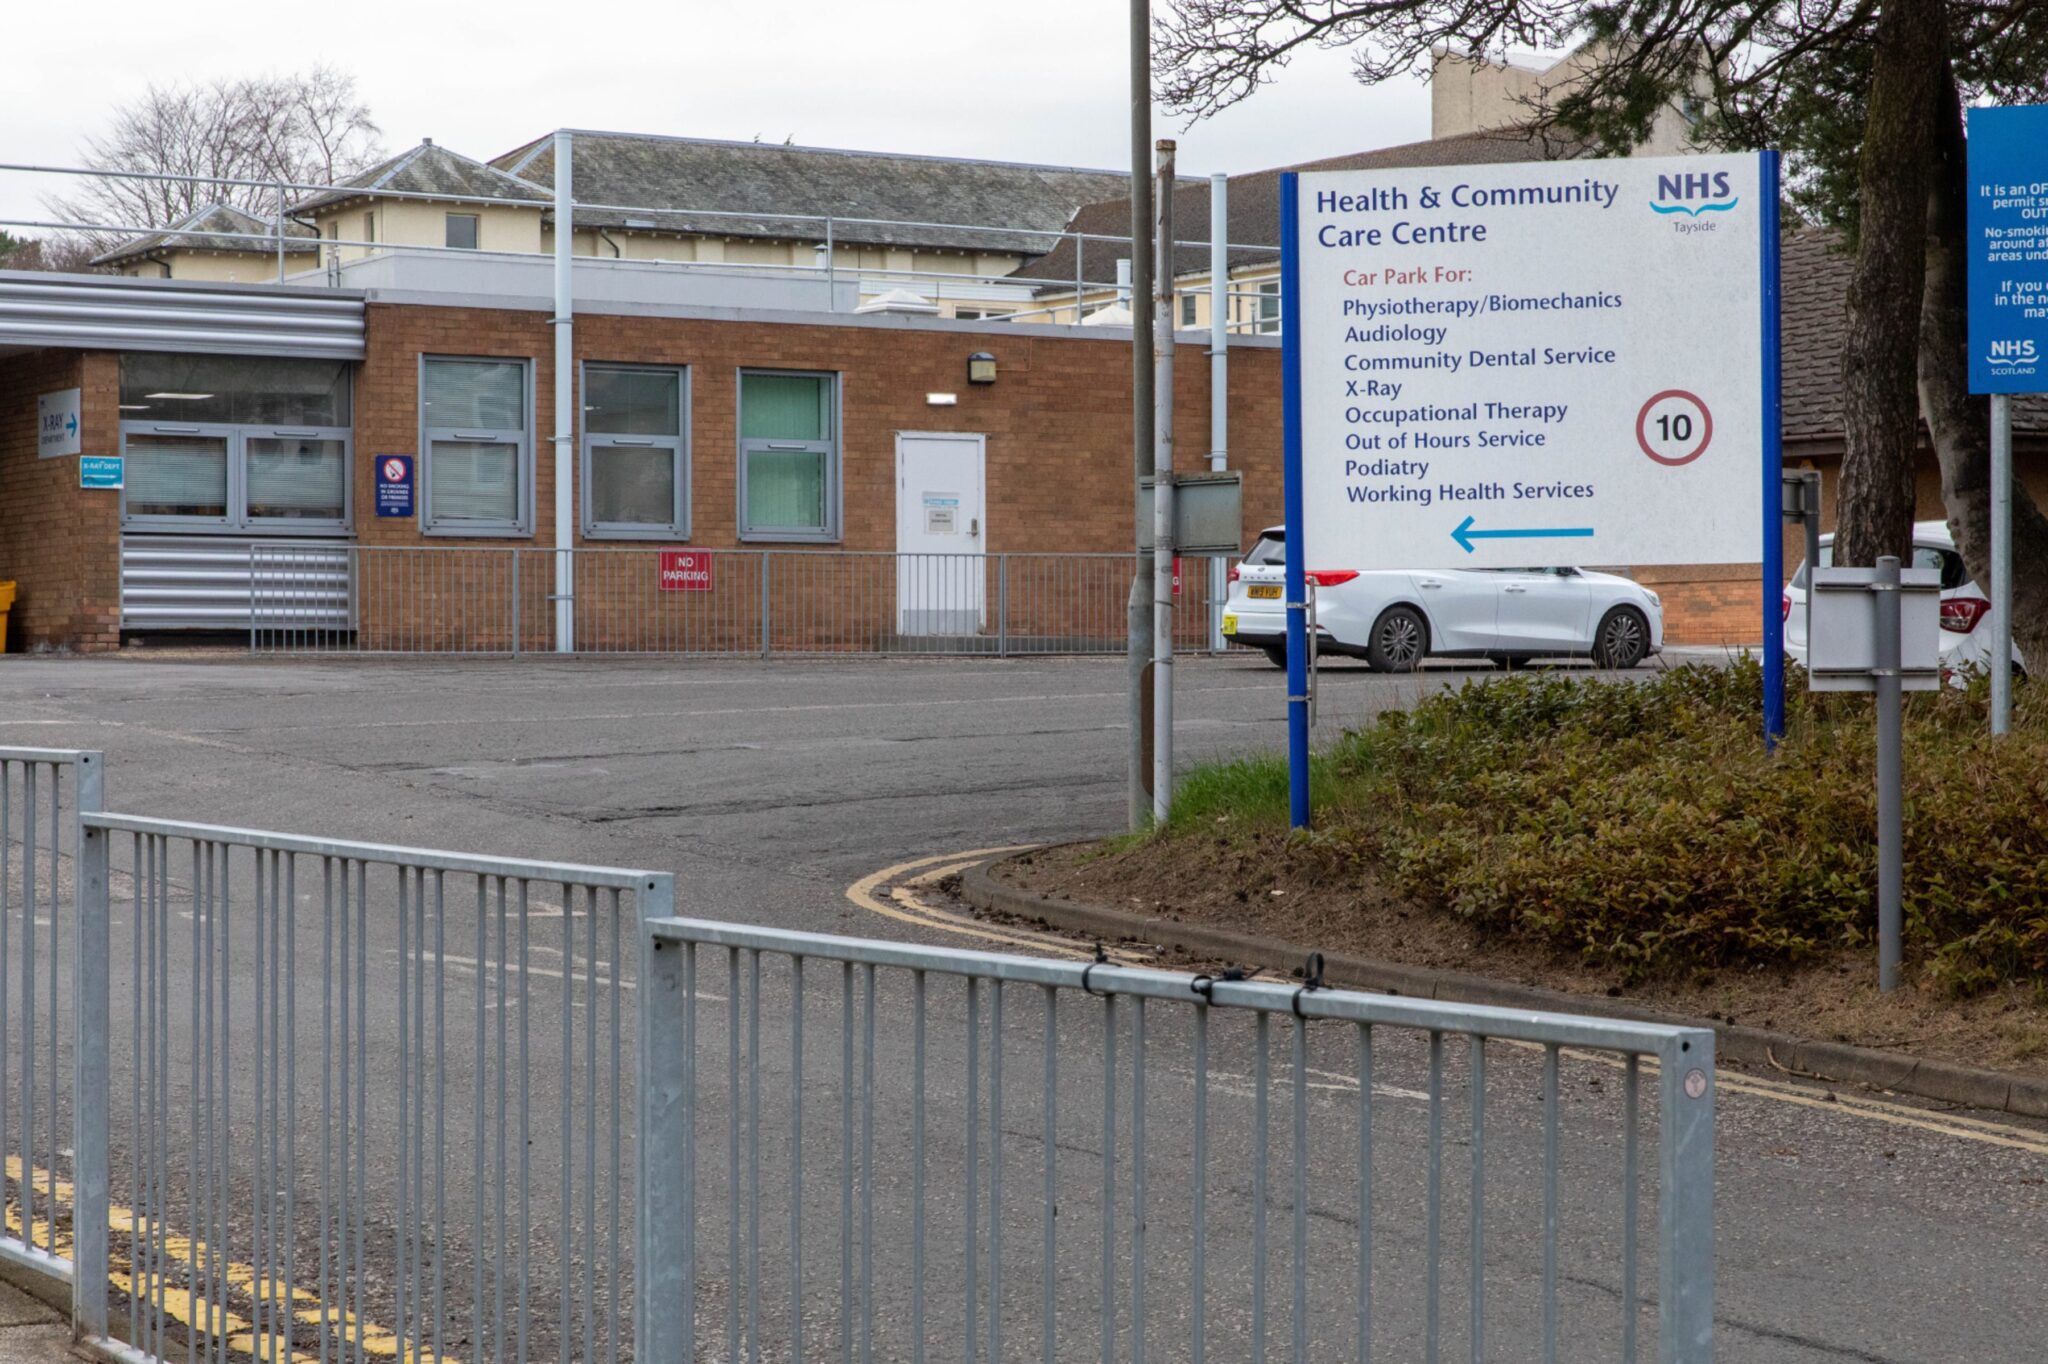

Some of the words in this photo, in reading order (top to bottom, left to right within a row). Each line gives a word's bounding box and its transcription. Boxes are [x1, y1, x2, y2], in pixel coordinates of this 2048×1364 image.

[1658, 171, 1730, 200] NHS
[1980, 185, 1991, 197] It
[1994, 184, 2006, 196] is
[2009, 185, 2026, 196] an
[1317, 187, 1408, 213] Health
[1419, 186, 1441, 209] &
[1451, 179, 1619, 208] Community
[1993, 196, 2036, 210] permit
[1318, 225, 1381, 247] Care
[1392, 222, 1487, 244] Centre
[1673, 221, 1716, 235] Tayside
[1989, 238, 2035, 250] around
[1988, 251, 2022, 262] areas
[1343, 269, 1378, 286] Car
[1384, 266, 1427, 285] Park
[1434, 266, 1472, 283] For:
[2001, 280, 2012, 293] If
[2016, 281, 2042, 294] you
[1343, 291, 1622, 320] Physiotherapy/Biomechanics
[1995, 293, 2008, 306] in
[2011, 292, 2034, 305] the
[2038, 295, 2048, 304] n
[1344, 324, 1447, 345] Audiology
[1991, 340, 2035, 356] NHS
[1344, 351, 1462, 373] Community
[1469, 348, 1536, 367] Dental
[1543, 347, 1616, 365] Service
[1991, 367, 2035, 375] SCOTLAND
[1345, 380, 1402, 401] X-Ray
[43, 413, 64, 432] X-RAY
[1345, 403, 1477, 426] Occupational
[1484, 402, 1568, 423] Therapy
[1656, 414, 1692, 441] 10
[1345, 434, 1381, 450] Out
[1388, 432, 1408, 449] of
[1414, 432, 1471, 449] Hours
[1478, 430, 1546, 447] Service
[1345, 459, 1429, 480] Podiatry
[1347, 485, 1432, 507] Working
[1439, 483, 1505, 501] Health
[1513, 481, 1595, 499] Services
[678, 557, 694, 567] NO
[663, 570, 709, 581] PARKING
